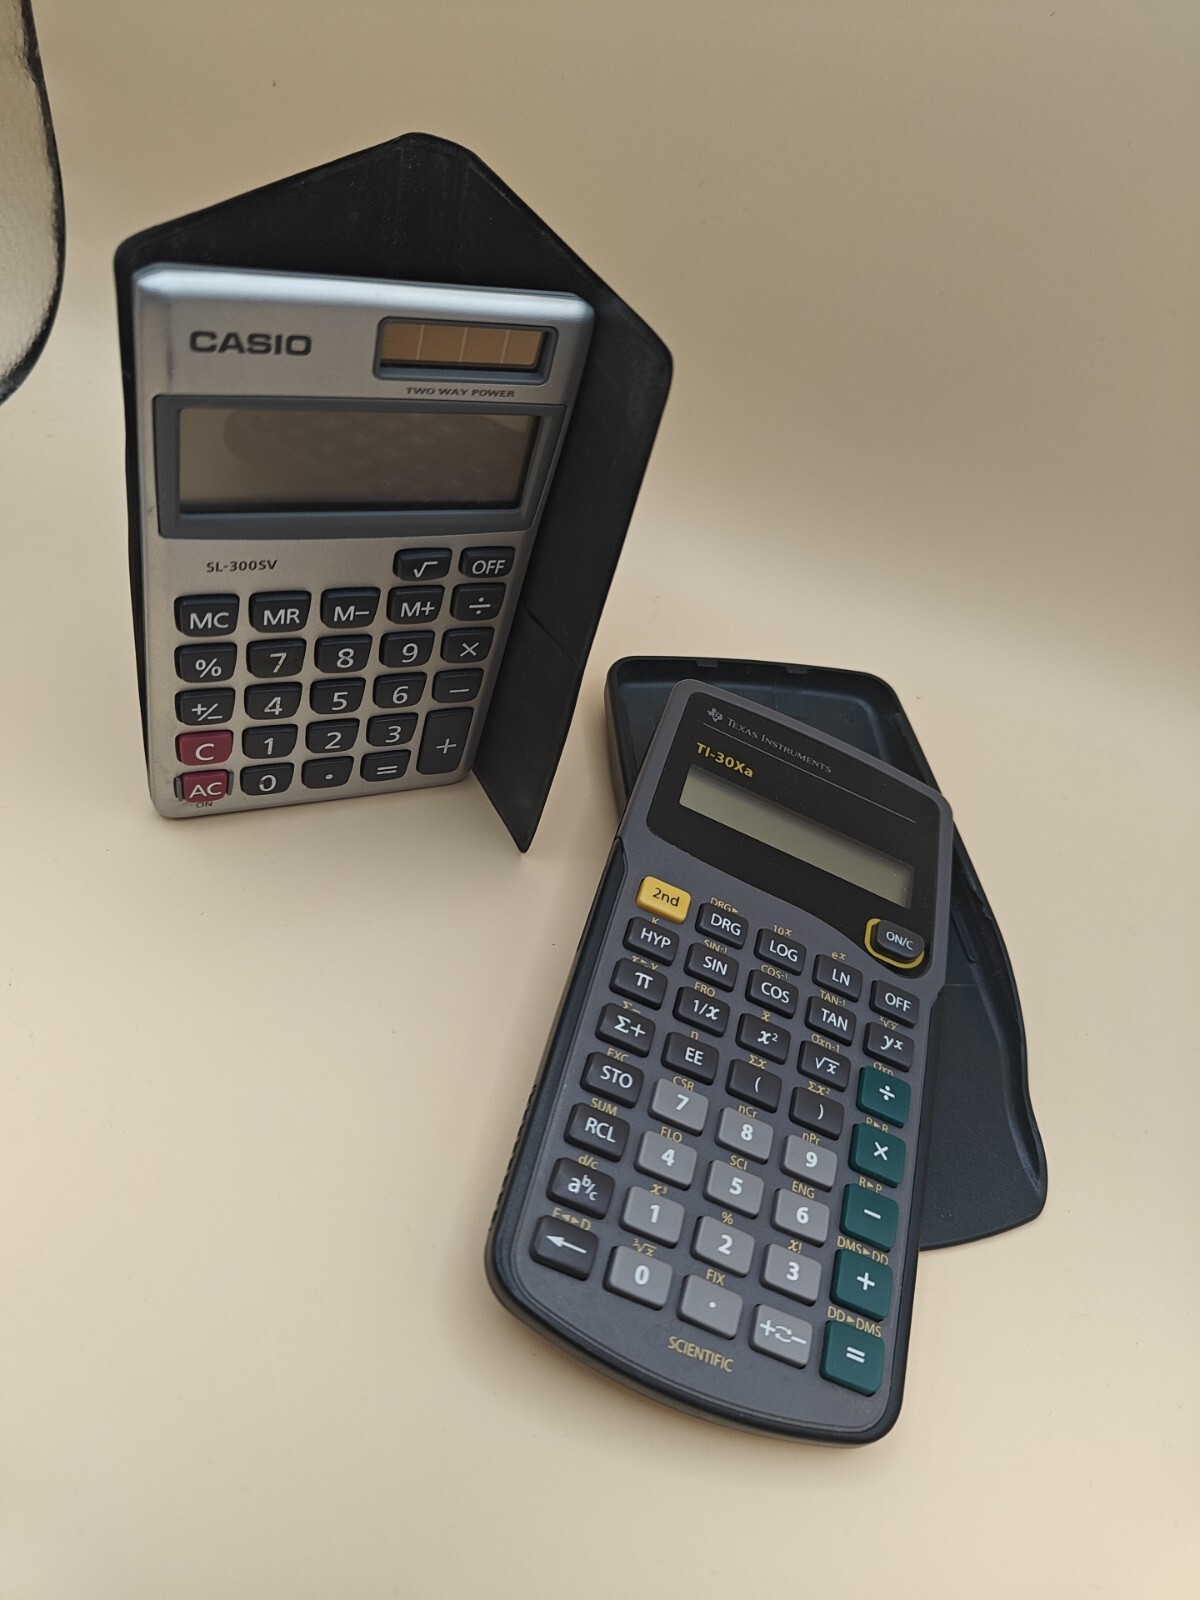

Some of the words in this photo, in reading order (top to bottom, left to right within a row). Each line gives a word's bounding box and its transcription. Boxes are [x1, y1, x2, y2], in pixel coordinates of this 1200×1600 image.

[190, 330, 312, 356] CASIO
[406, 387, 434, 397] TWO
[436, 388, 468, 397] WAY
[472, 389, 515, 398] POWER
[206, 560, 278, 572] SL-300SV
[471, 560, 505, 575] OFF
[263, 609, 300, 625] MR
[401, 602, 434, 617] M+
[190, 612, 229, 629] MC
[336, 649, 354, 668] 8
[402, 643, 418, 662] 9
[195, 659, 222, 677] %
[269, 652, 287, 673] 7
[332, 691, 348, 710] 5
[392, 686, 408, 704] 6
[264, 697, 282, 715] 4
[325, 732, 342, 749] 2
[385, 726, 401, 743] 3
[195, 743, 214, 761] C
[264, 738, 274, 754] 1
[696, 742, 753, 778] TI-30Xa
[189, 782, 222, 798] AC
[259, 775, 277, 792] 0
[652, 887, 680, 907] 2nd
[710, 897, 732, 912] DRG
[710, 914, 741, 936] DRG
[641, 929, 671, 948] HYP
[886, 931, 914, 951] ON/C
[770, 940, 798, 962] LOG
[703, 956, 728, 975] SIN
[832, 969, 850, 986] LN
[694, 981, 716, 997] FRO
[761, 983, 790, 1003] COS
[885, 993, 911, 1012] OFF
[821, 1009, 848, 1031] TAN
[685, 1047, 704, 1066] EE
[600, 1065, 633, 1088] STO
[673, 1076, 694, 1091] CSR
[591, 1097, 618, 1115] SUM
[675, 1096, 690, 1111] 7
[738, 1104, 757, 1119] nCr
[585, 1119, 615, 1142] RCL
[660, 1126, 683, 1142] FLO
[740, 1124, 753, 1141] 8
[802, 1132, 820, 1145] nPr
[578, 1154, 599, 1170] d/c
[661, 1150, 675, 1166] 4
[730, 1155, 748, 1171] SCI
[805, 1152, 818, 1168] 9
[729, 1178, 742, 1196] 5
[792, 1181, 815, 1199] ENG
[650, 1205, 660, 1223] 1
[721, 1213, 734, 1225] %
[796, 1207, 809, 1224] 6
[719, 1235, 732, 1253] 2
[634, 1265, 650, 1285] 0
[706, 1268, 725, 1286] FIX
[786, 1262, 799, 1280] 3
[668, 1336, 734, 1371] SCIENTIFIC
